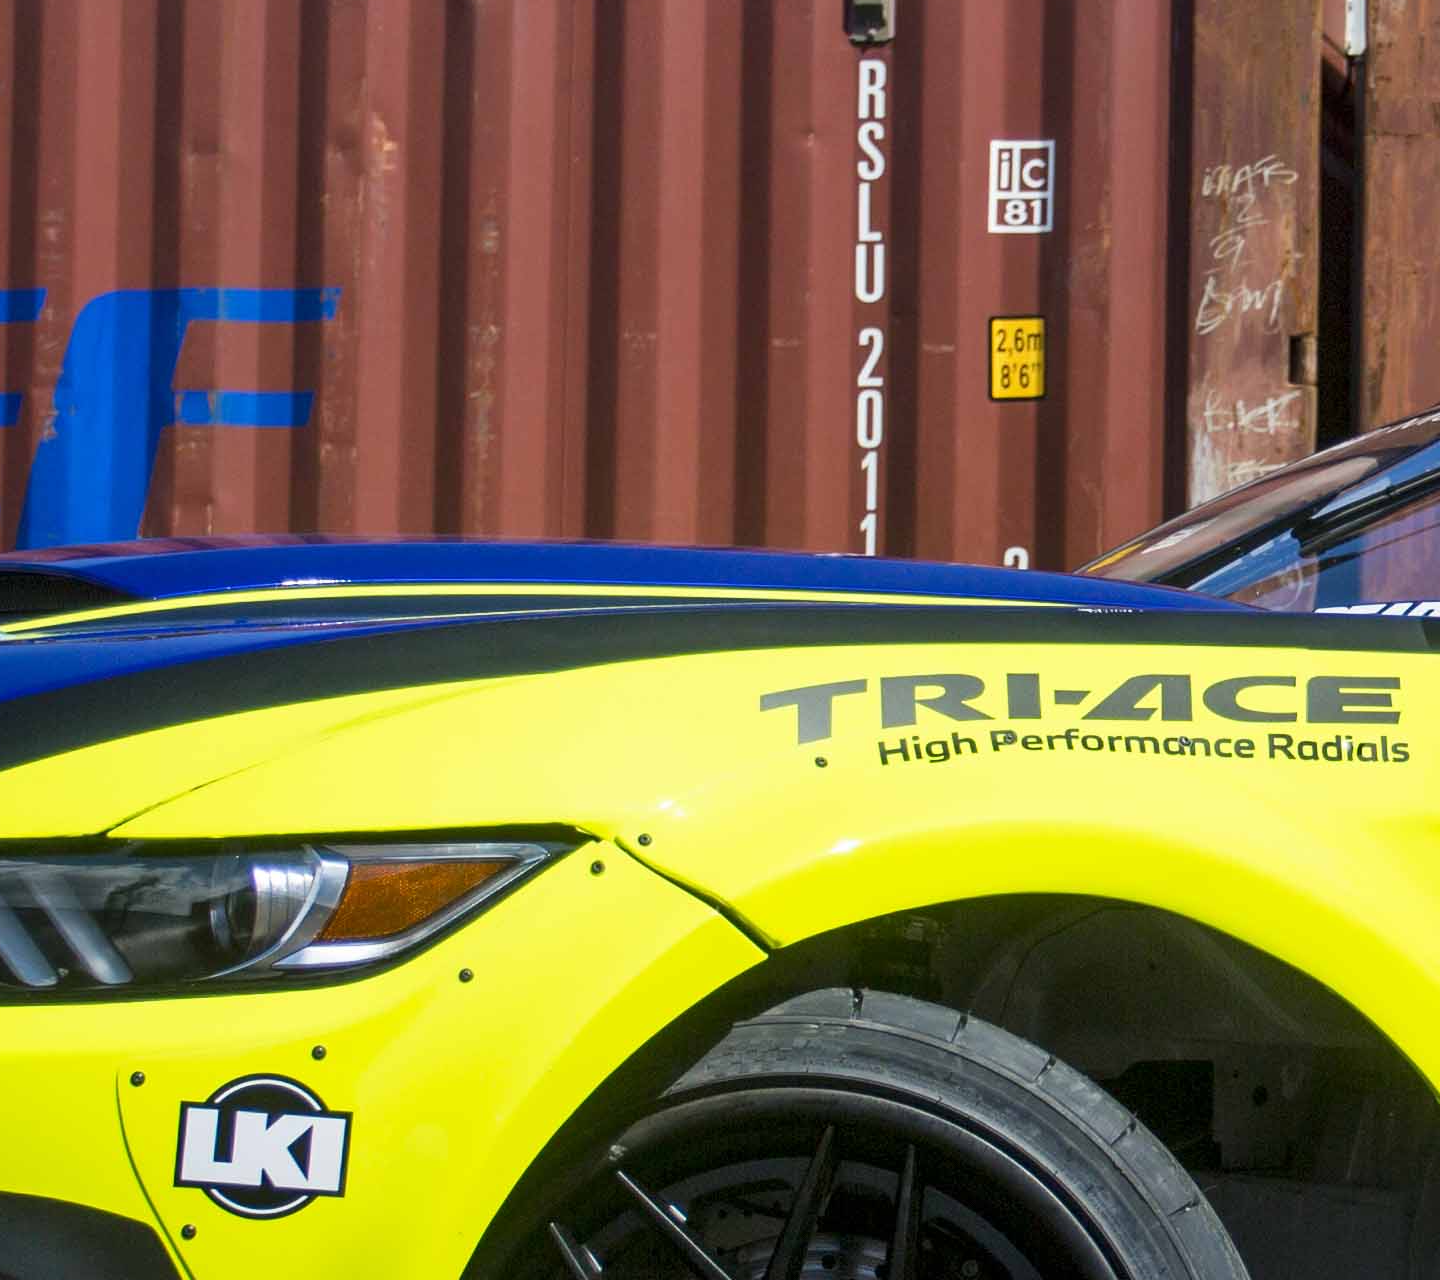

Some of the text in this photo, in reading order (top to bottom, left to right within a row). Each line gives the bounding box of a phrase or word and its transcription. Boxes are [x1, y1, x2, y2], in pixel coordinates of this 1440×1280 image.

[854, 59, 887, 303] RSLU
[1003, 200, 1043, 226] 81
[759, 673, 1402, 745] TRI-ACE
[878, 727, 1410, 766] High Performance Radials
